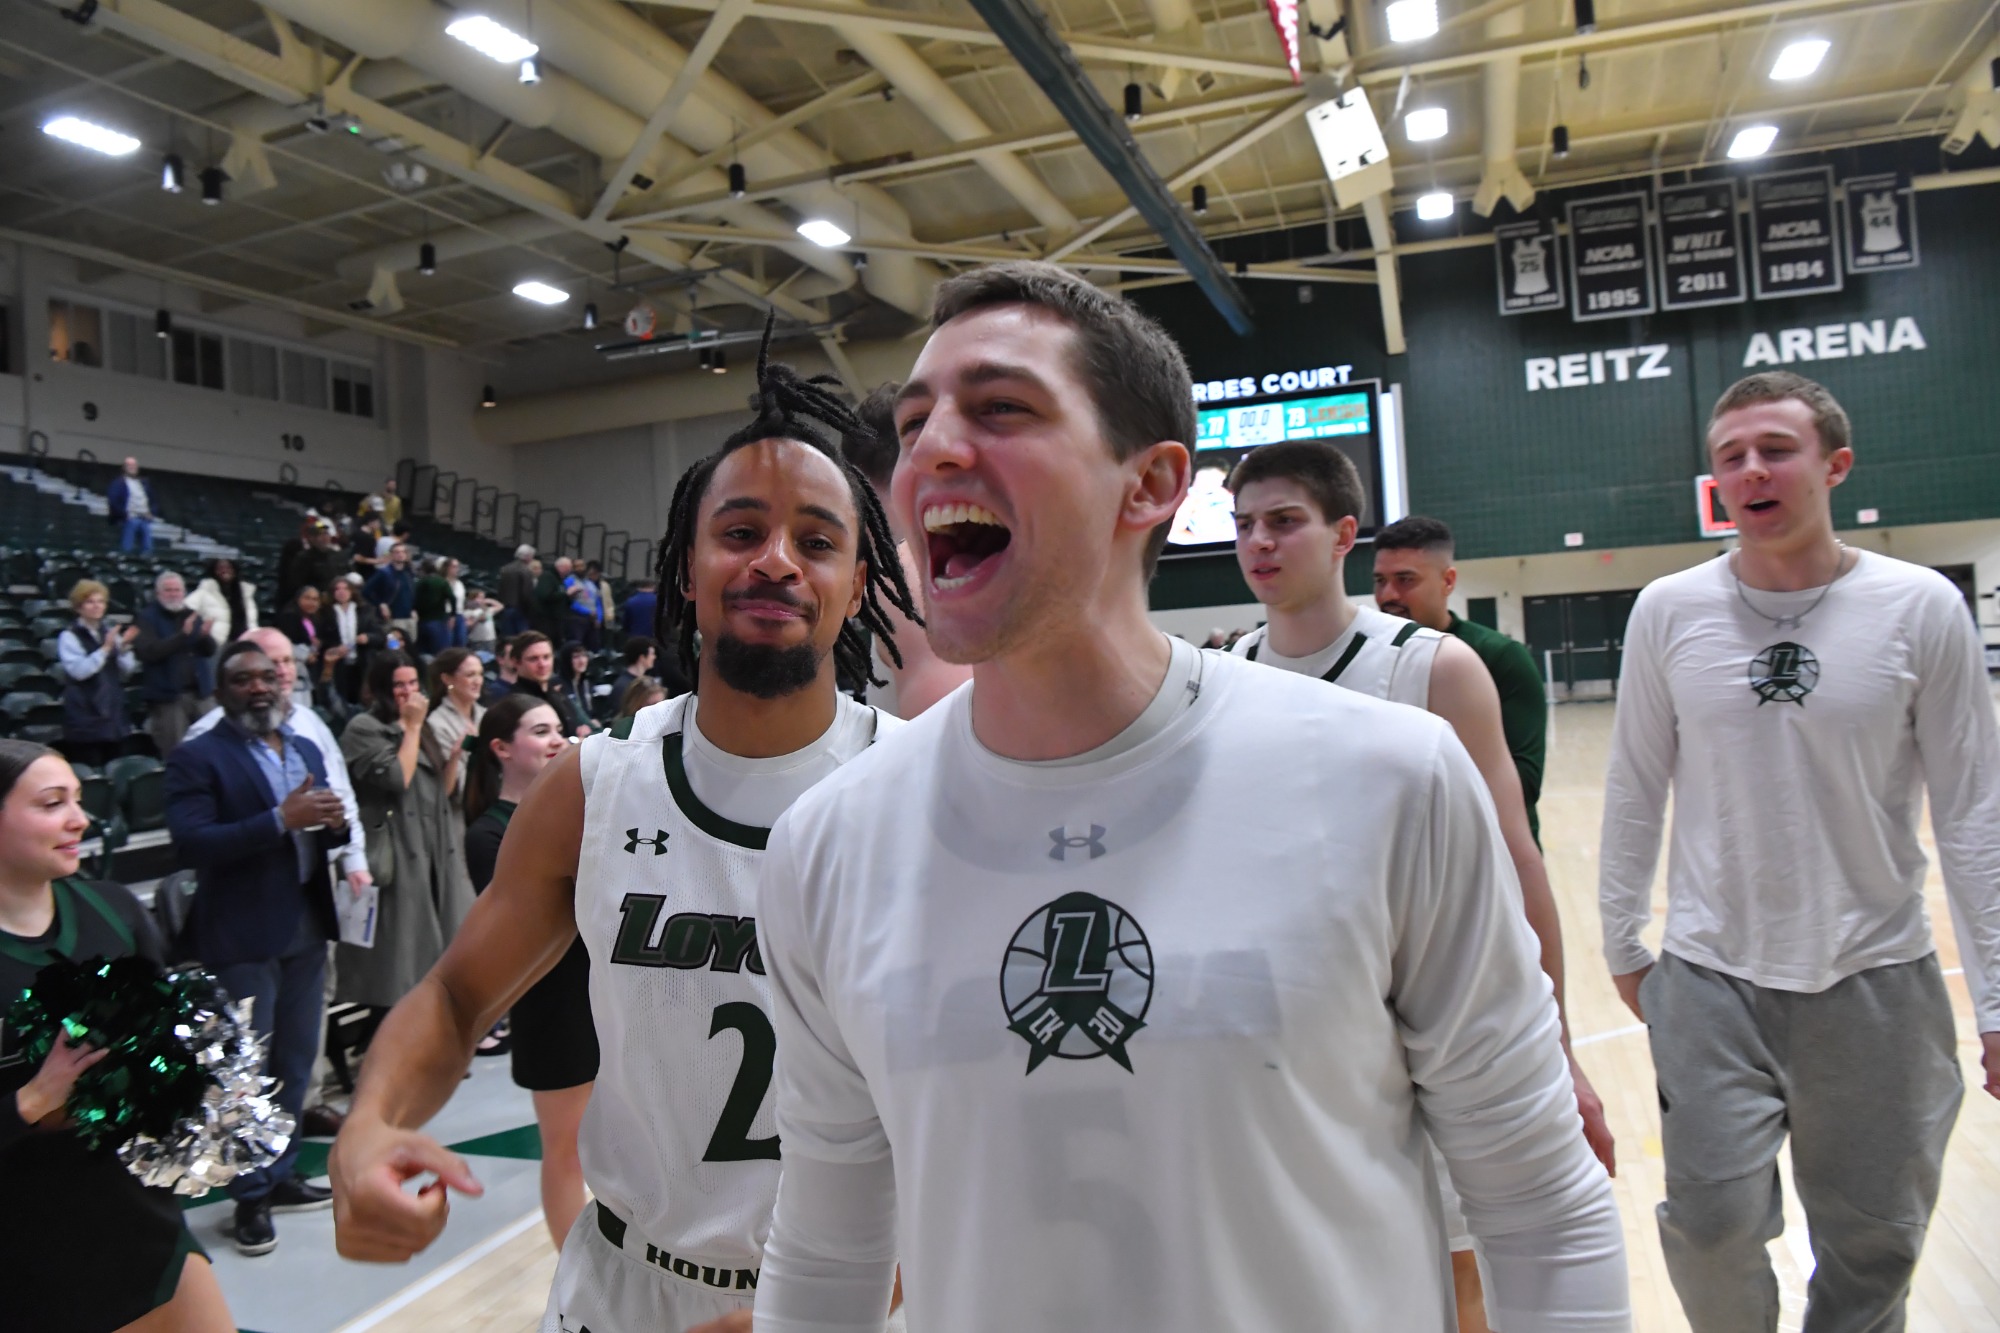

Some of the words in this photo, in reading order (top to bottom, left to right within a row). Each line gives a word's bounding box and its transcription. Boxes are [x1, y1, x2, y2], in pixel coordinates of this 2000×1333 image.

[1768, 218, 1821, 240] NCAA
[1870, 215, 1892, 228] 44
[1584, 243, 1636, 264] NCAA
[1677, 271, 1728, 294] 2011
[1769, 260, 1825, 283] 1994
[1587, 287, 1641, 310] 1995
[1525, 344, 1671, 391] REITZ
[1743, 316, 1927, 368] ARENA
[1261, 365, 1353, 394] COURT
[82, 401, 98, 421] 9
[281, 433, 305, 451] 10
[1043, 911, 1109, 993] L
[1028, 1007, 1066, 1046] CK
[1087, 1006, 1126, 1046] 20
[702, 1001, 782, 1163] 2
